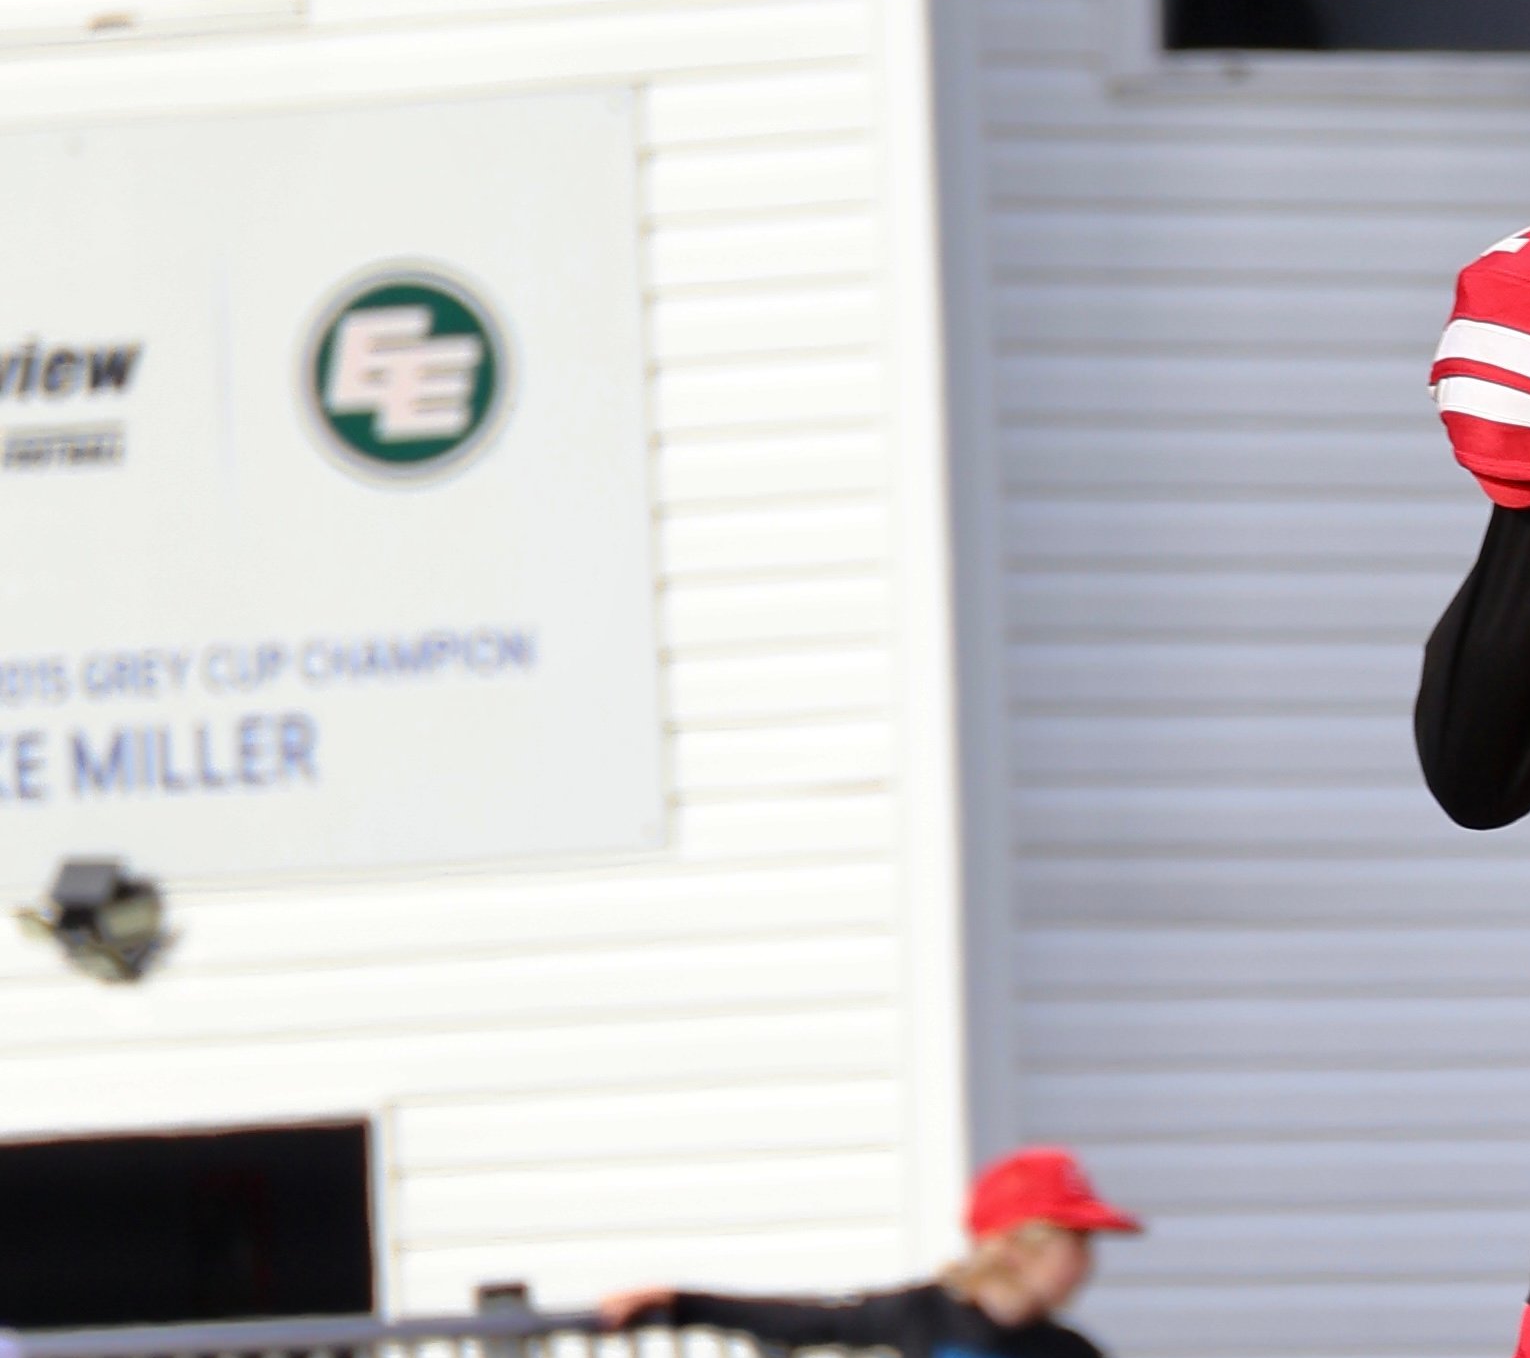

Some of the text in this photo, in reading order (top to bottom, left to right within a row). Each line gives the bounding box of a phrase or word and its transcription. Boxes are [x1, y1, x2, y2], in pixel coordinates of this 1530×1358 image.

[81, 646, 192, 698] GREY
[204, 643, 286, 690] CUP
[301, 630, 537, 686] CHAMPION
[0, 715, 319, 799] E MILLER
